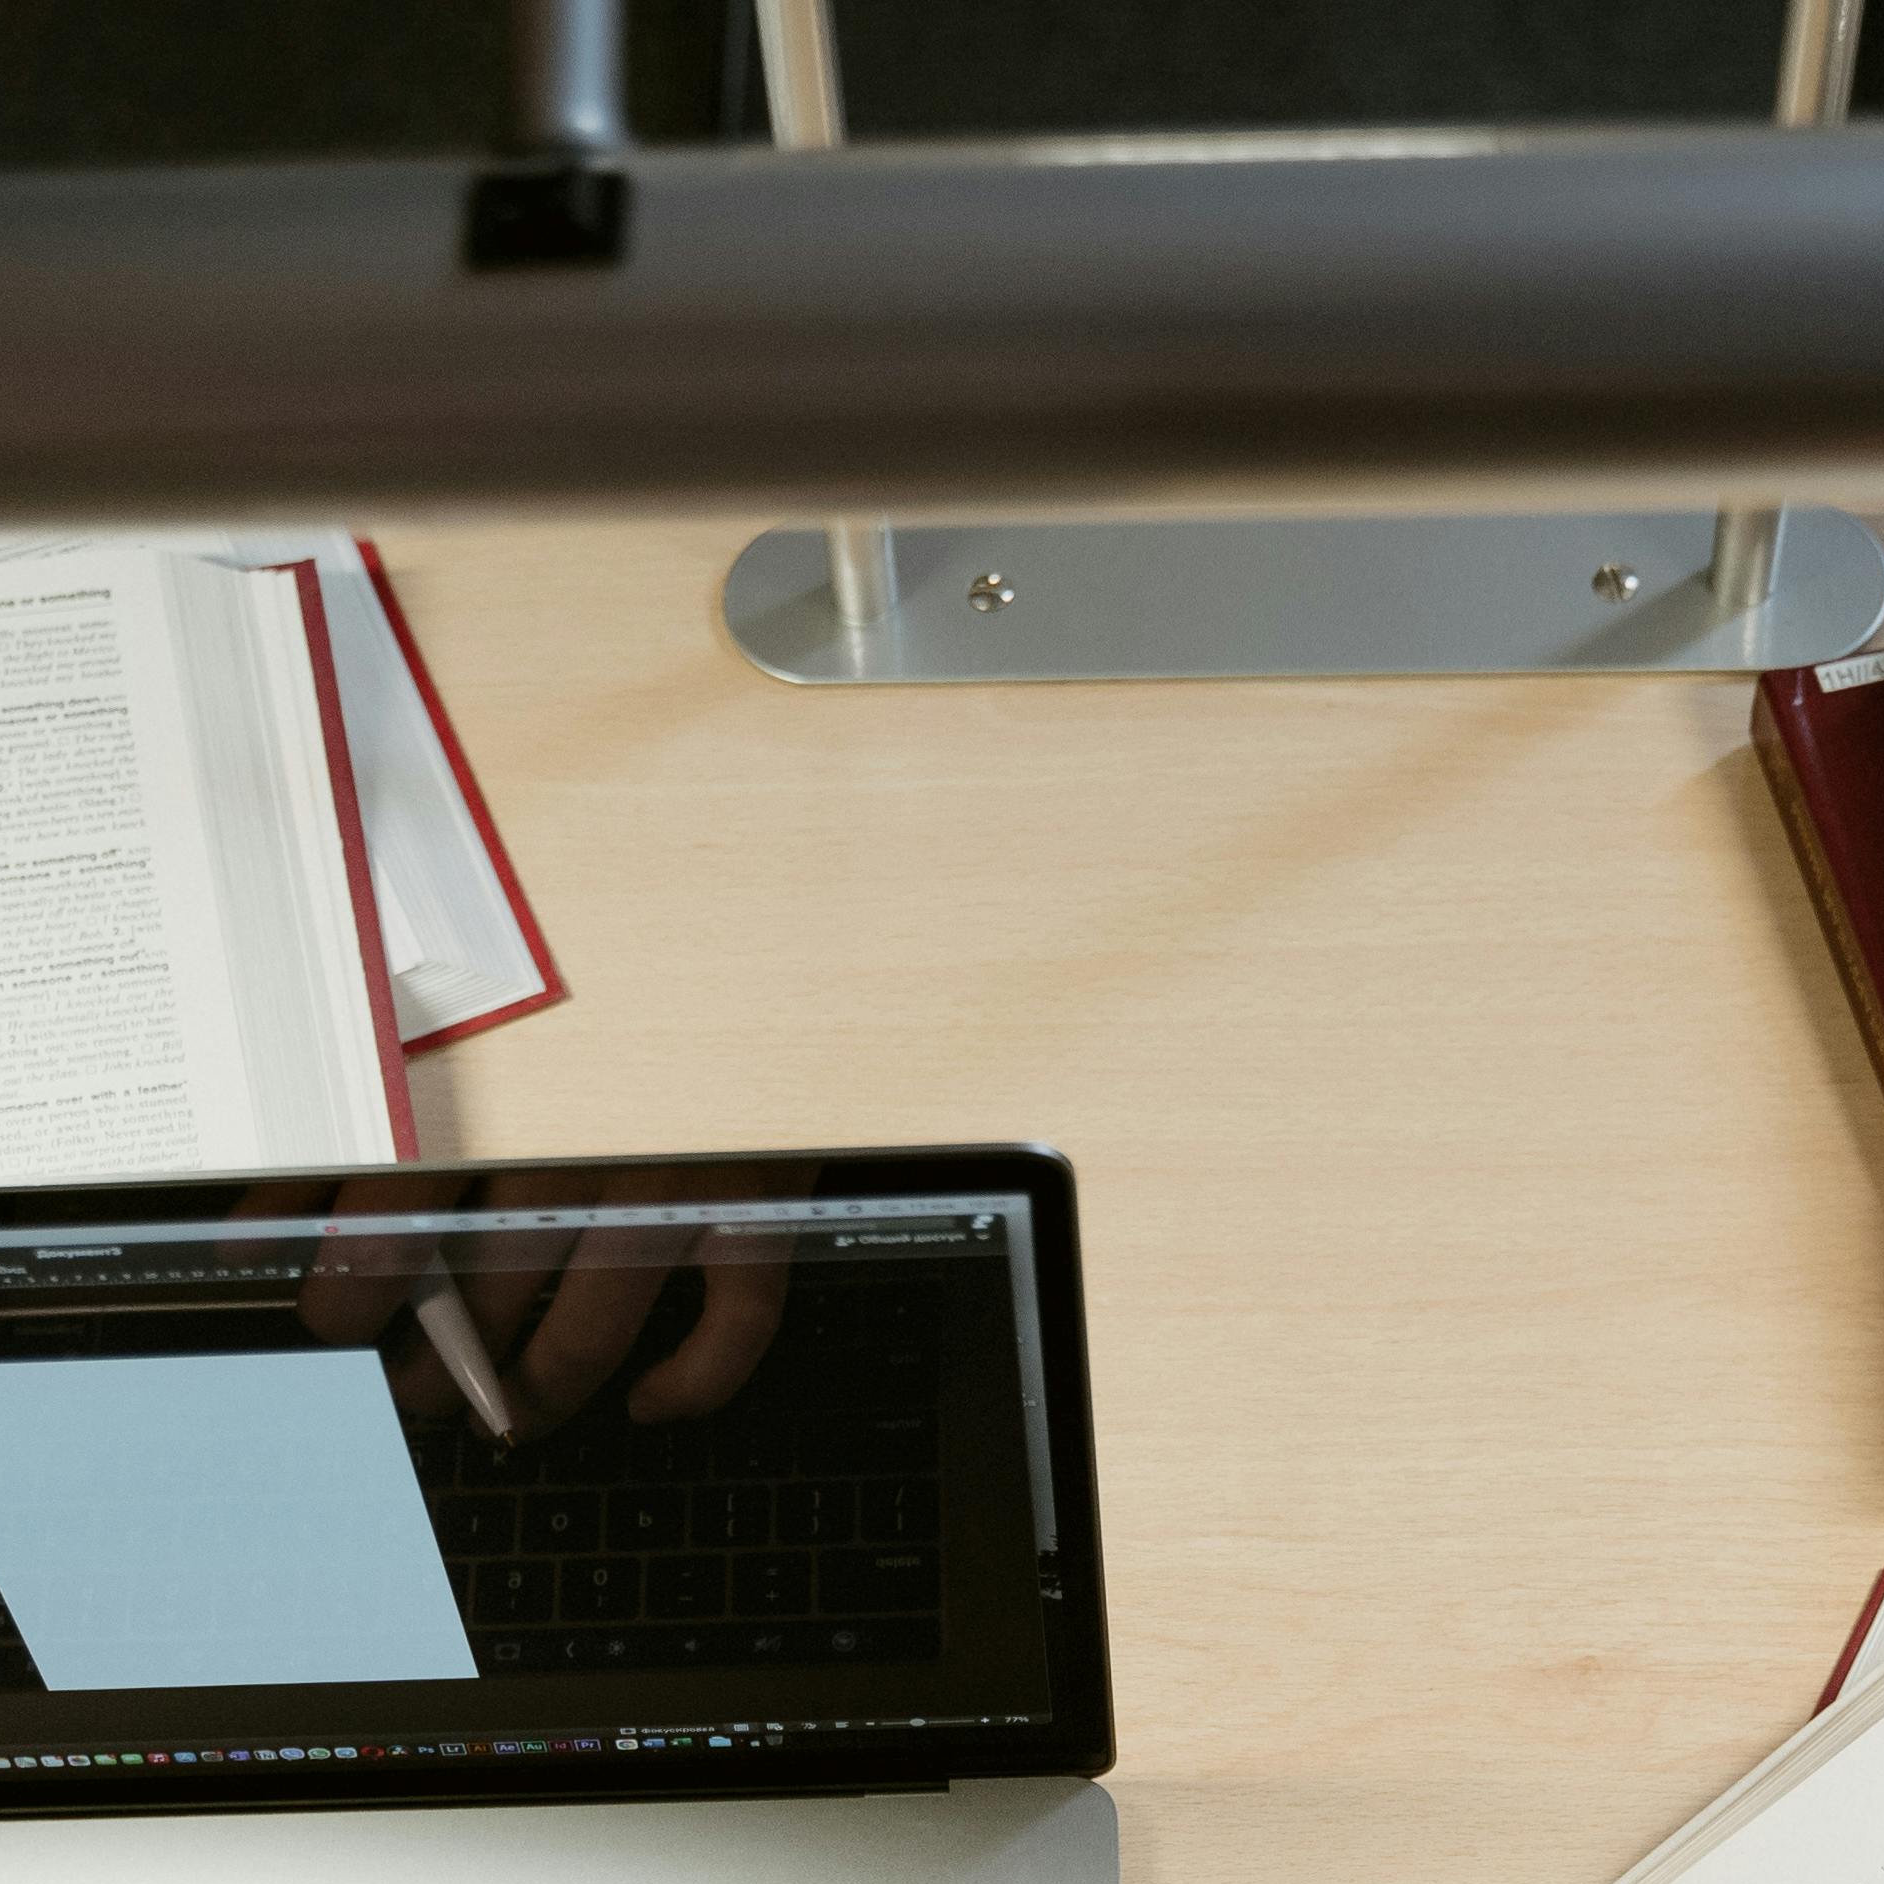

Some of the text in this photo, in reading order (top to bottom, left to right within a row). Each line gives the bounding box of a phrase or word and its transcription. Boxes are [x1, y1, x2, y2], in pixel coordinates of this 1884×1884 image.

[19, 597, 34, 605] or
[38, 587, 112, 604] something
[54, 1094, 83, 1106] over
[89, 1088, 116, 1101] with
